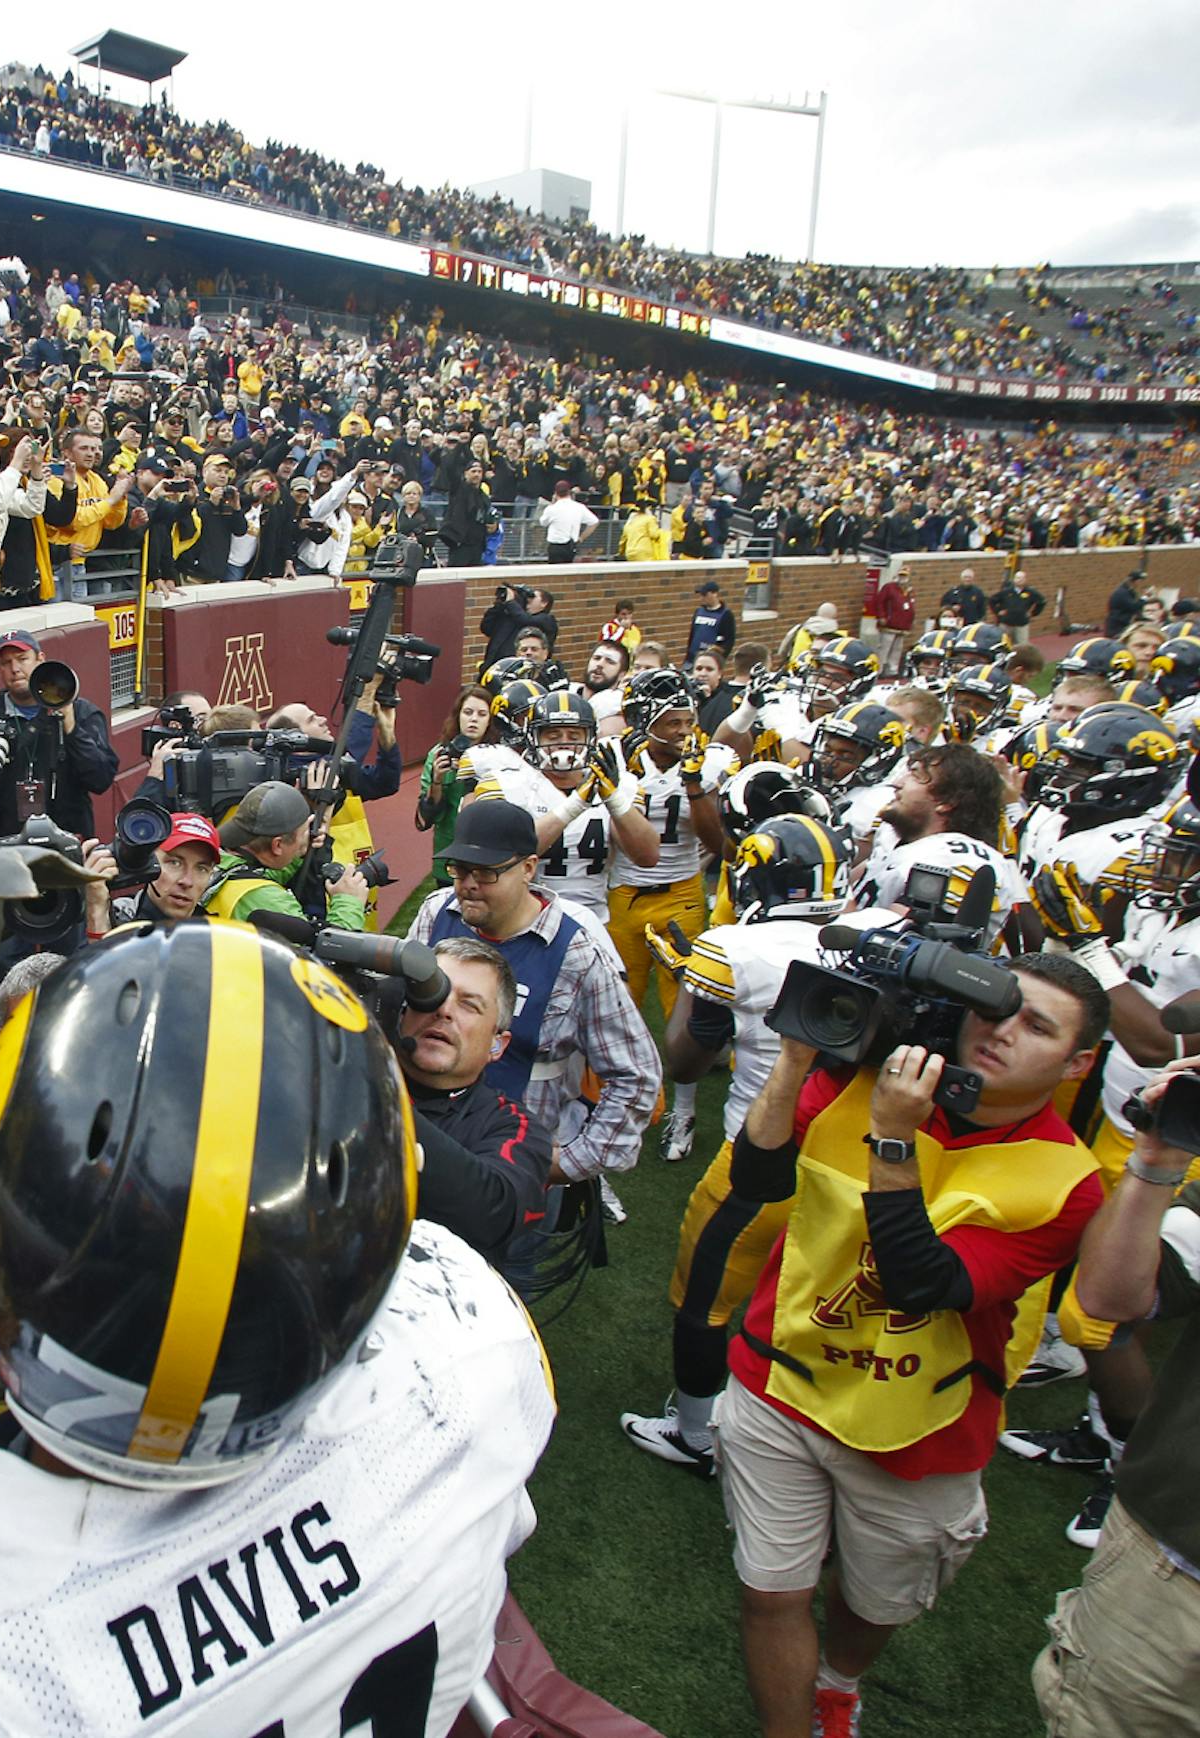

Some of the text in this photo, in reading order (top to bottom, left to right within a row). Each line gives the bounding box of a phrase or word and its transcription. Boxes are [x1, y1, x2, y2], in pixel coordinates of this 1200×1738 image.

[1066, 386, 1092, 401] 1910
[1100, 387, 1127, 401] 1911
[1136, 388, 1165, 402] 1915
[1175, 389, 1200, 402] 192
[114, 611, 135, 640] 105
[216, 632, 275, 712] M
[812, 861, 849, 898] 14
[106, 1501, 362, 1720] DAVIS
